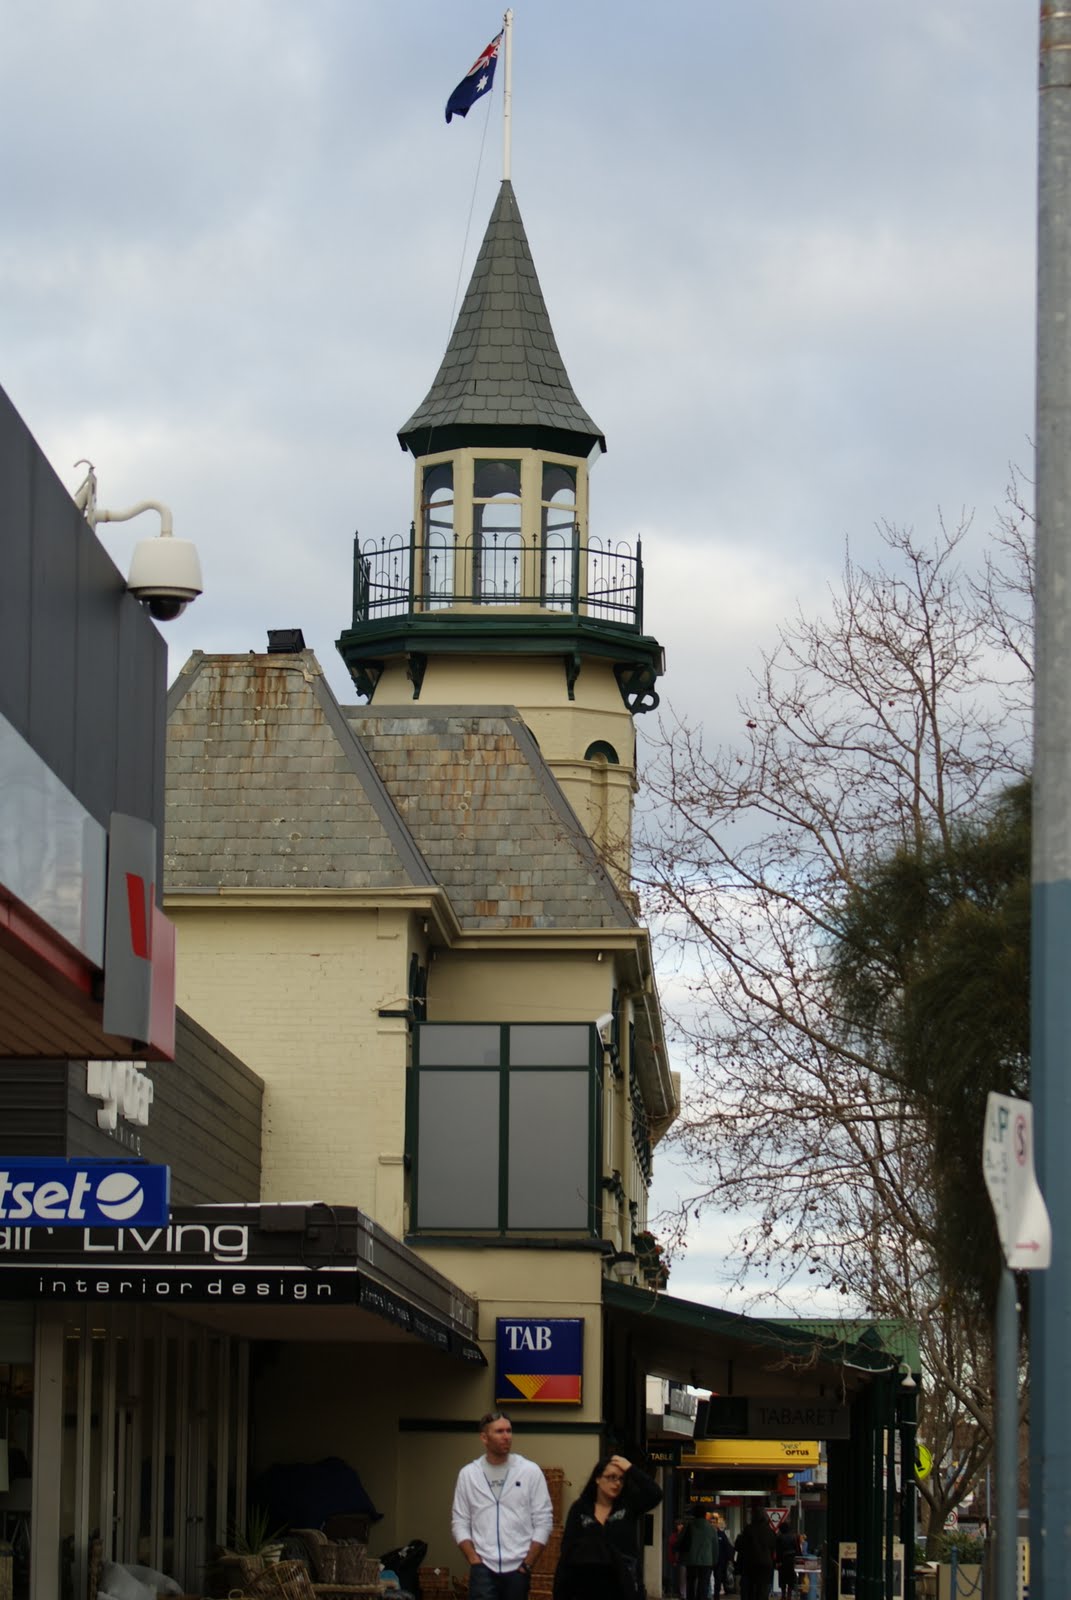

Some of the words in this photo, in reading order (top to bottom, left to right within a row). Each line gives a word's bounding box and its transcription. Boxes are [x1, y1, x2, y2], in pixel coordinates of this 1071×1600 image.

[39, 1277, 193, 1294] interior
[207, 1279, 332, 1299] design
[505, 1326, 552, 1351] TAB
[758, 1407, 839, 1425] TABARET
